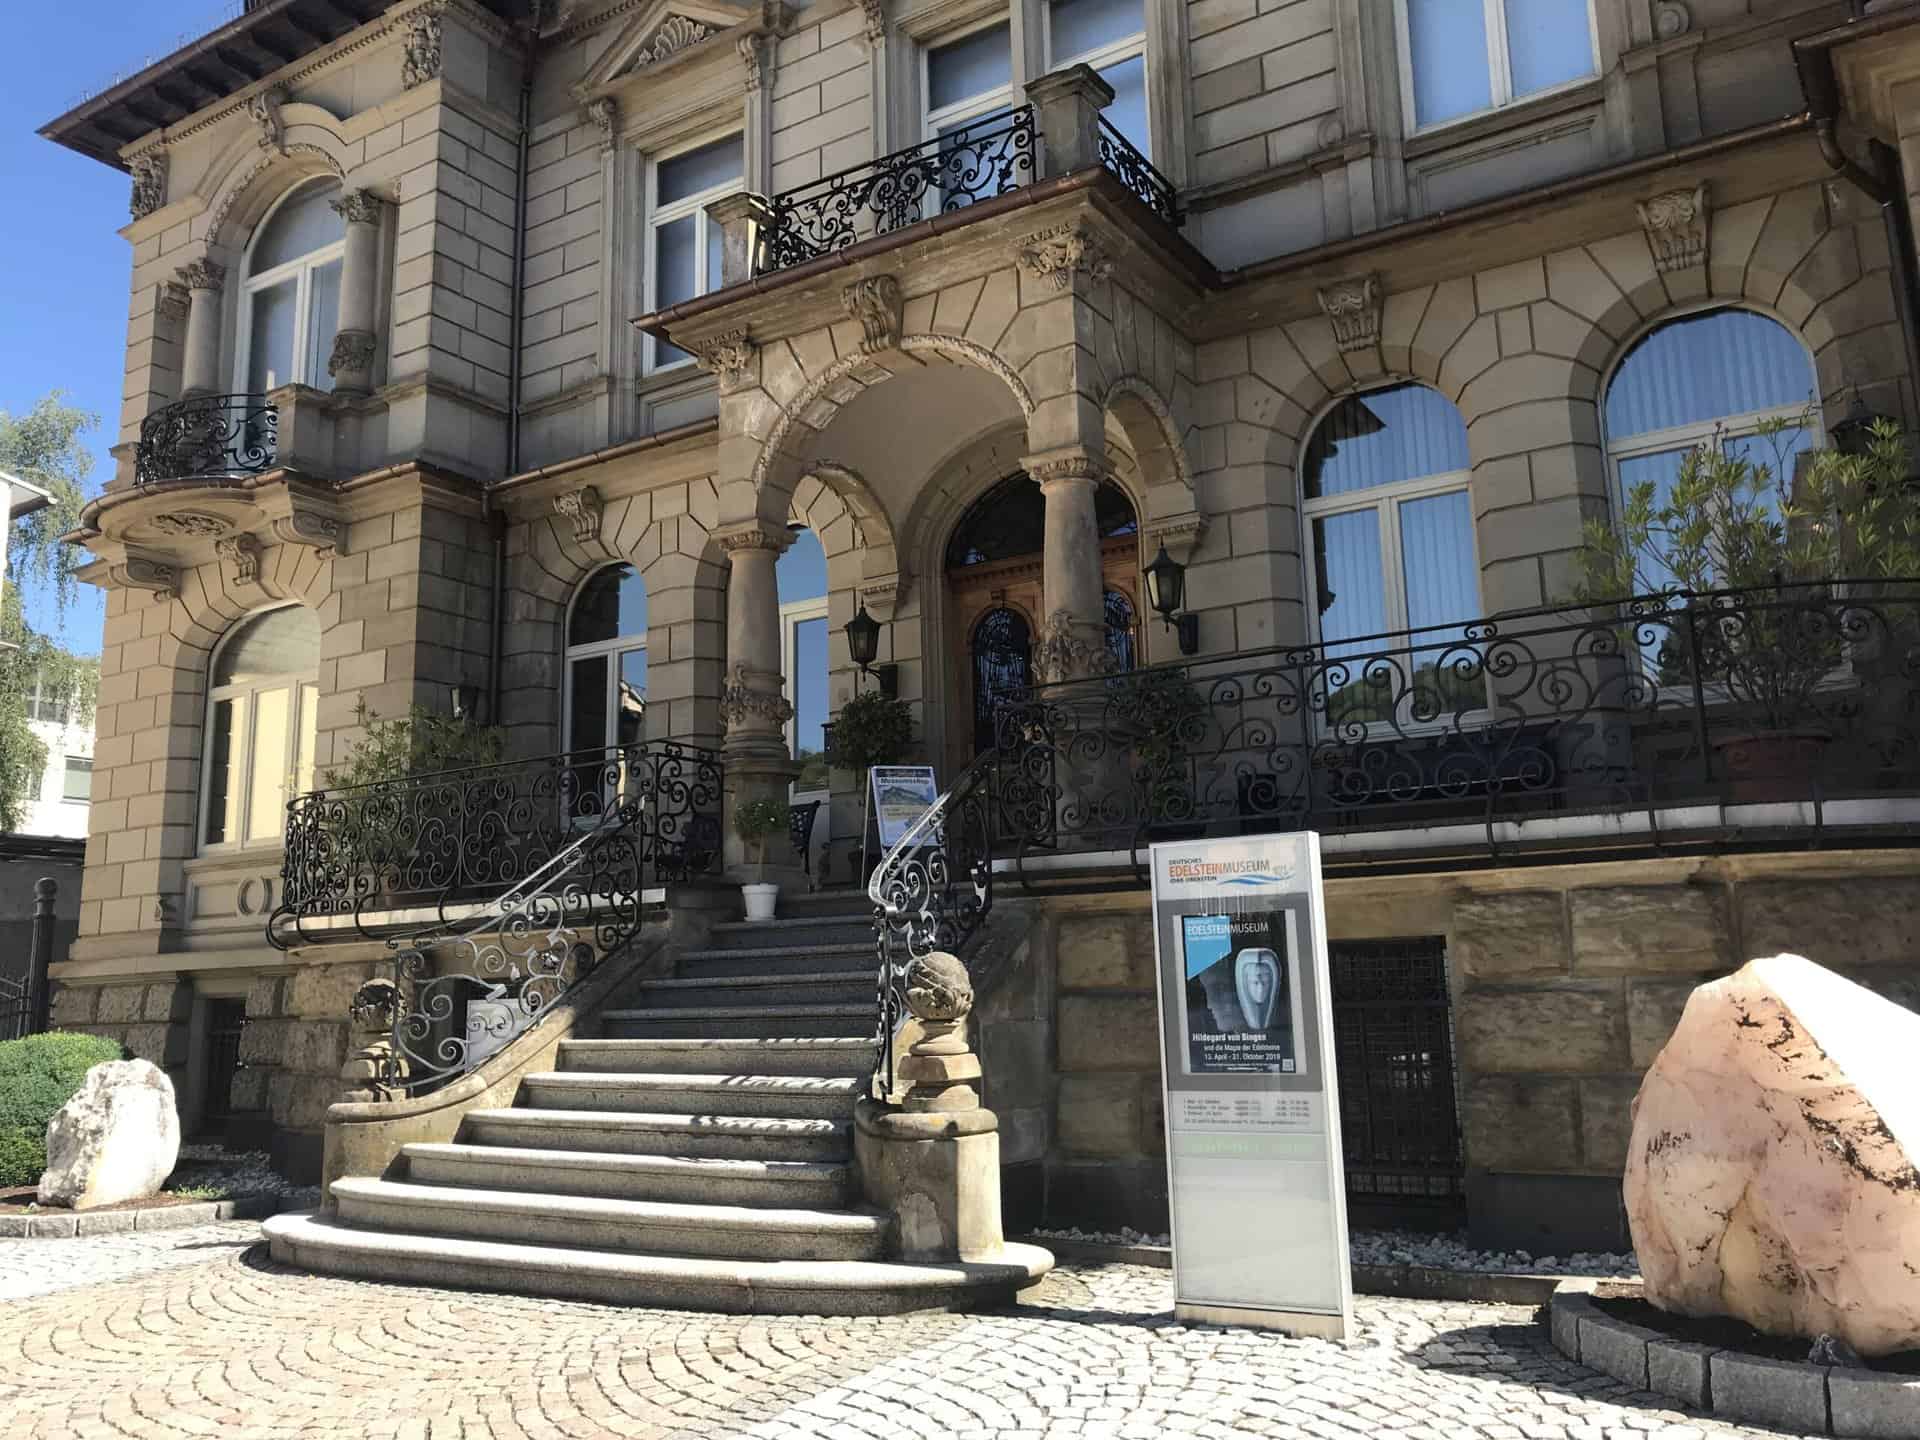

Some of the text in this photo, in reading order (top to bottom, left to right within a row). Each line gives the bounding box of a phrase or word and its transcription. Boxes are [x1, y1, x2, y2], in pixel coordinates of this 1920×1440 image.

[1187, 922, 1269, 935] EDELSTEINMUSEUM
[1192, 1032, 1226, 1042] Hildegard
[1241, 1033, 1267, 1043] Bingen
